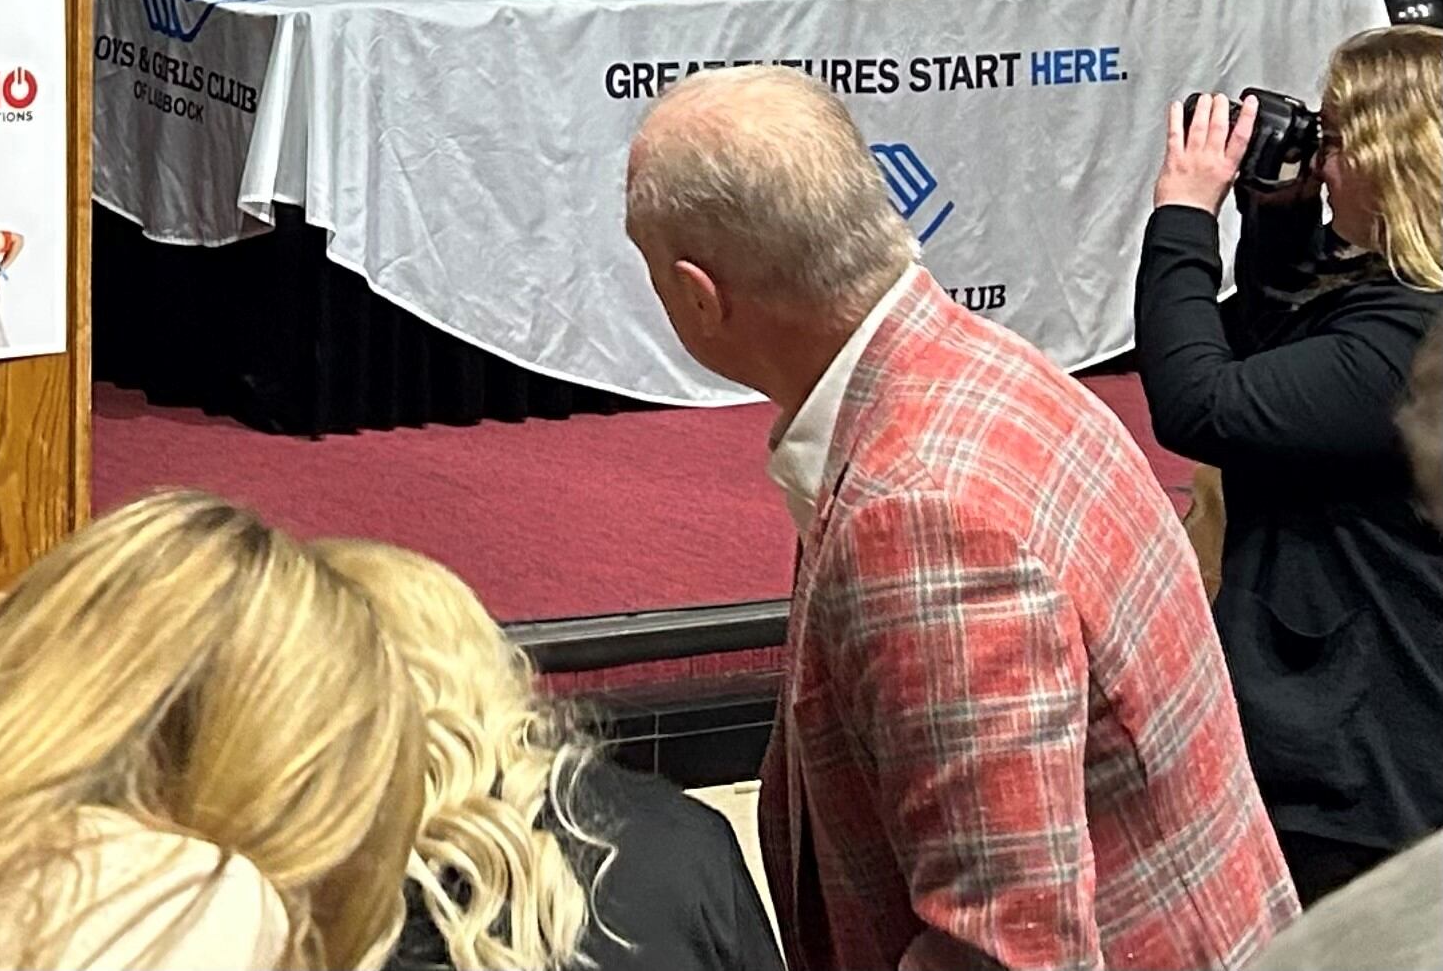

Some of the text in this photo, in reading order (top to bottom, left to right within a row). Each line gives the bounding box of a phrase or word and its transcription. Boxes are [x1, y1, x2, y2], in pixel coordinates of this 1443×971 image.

[94, 35, 135, 68] OYS
[139, 46, 150, 74] &
[207, 70, 257, 114] CLUB
[605, 61, 726, 99] GRE
[908, 52, 1021, 93] START
[1031, 47, 1128, 86] HERE.
